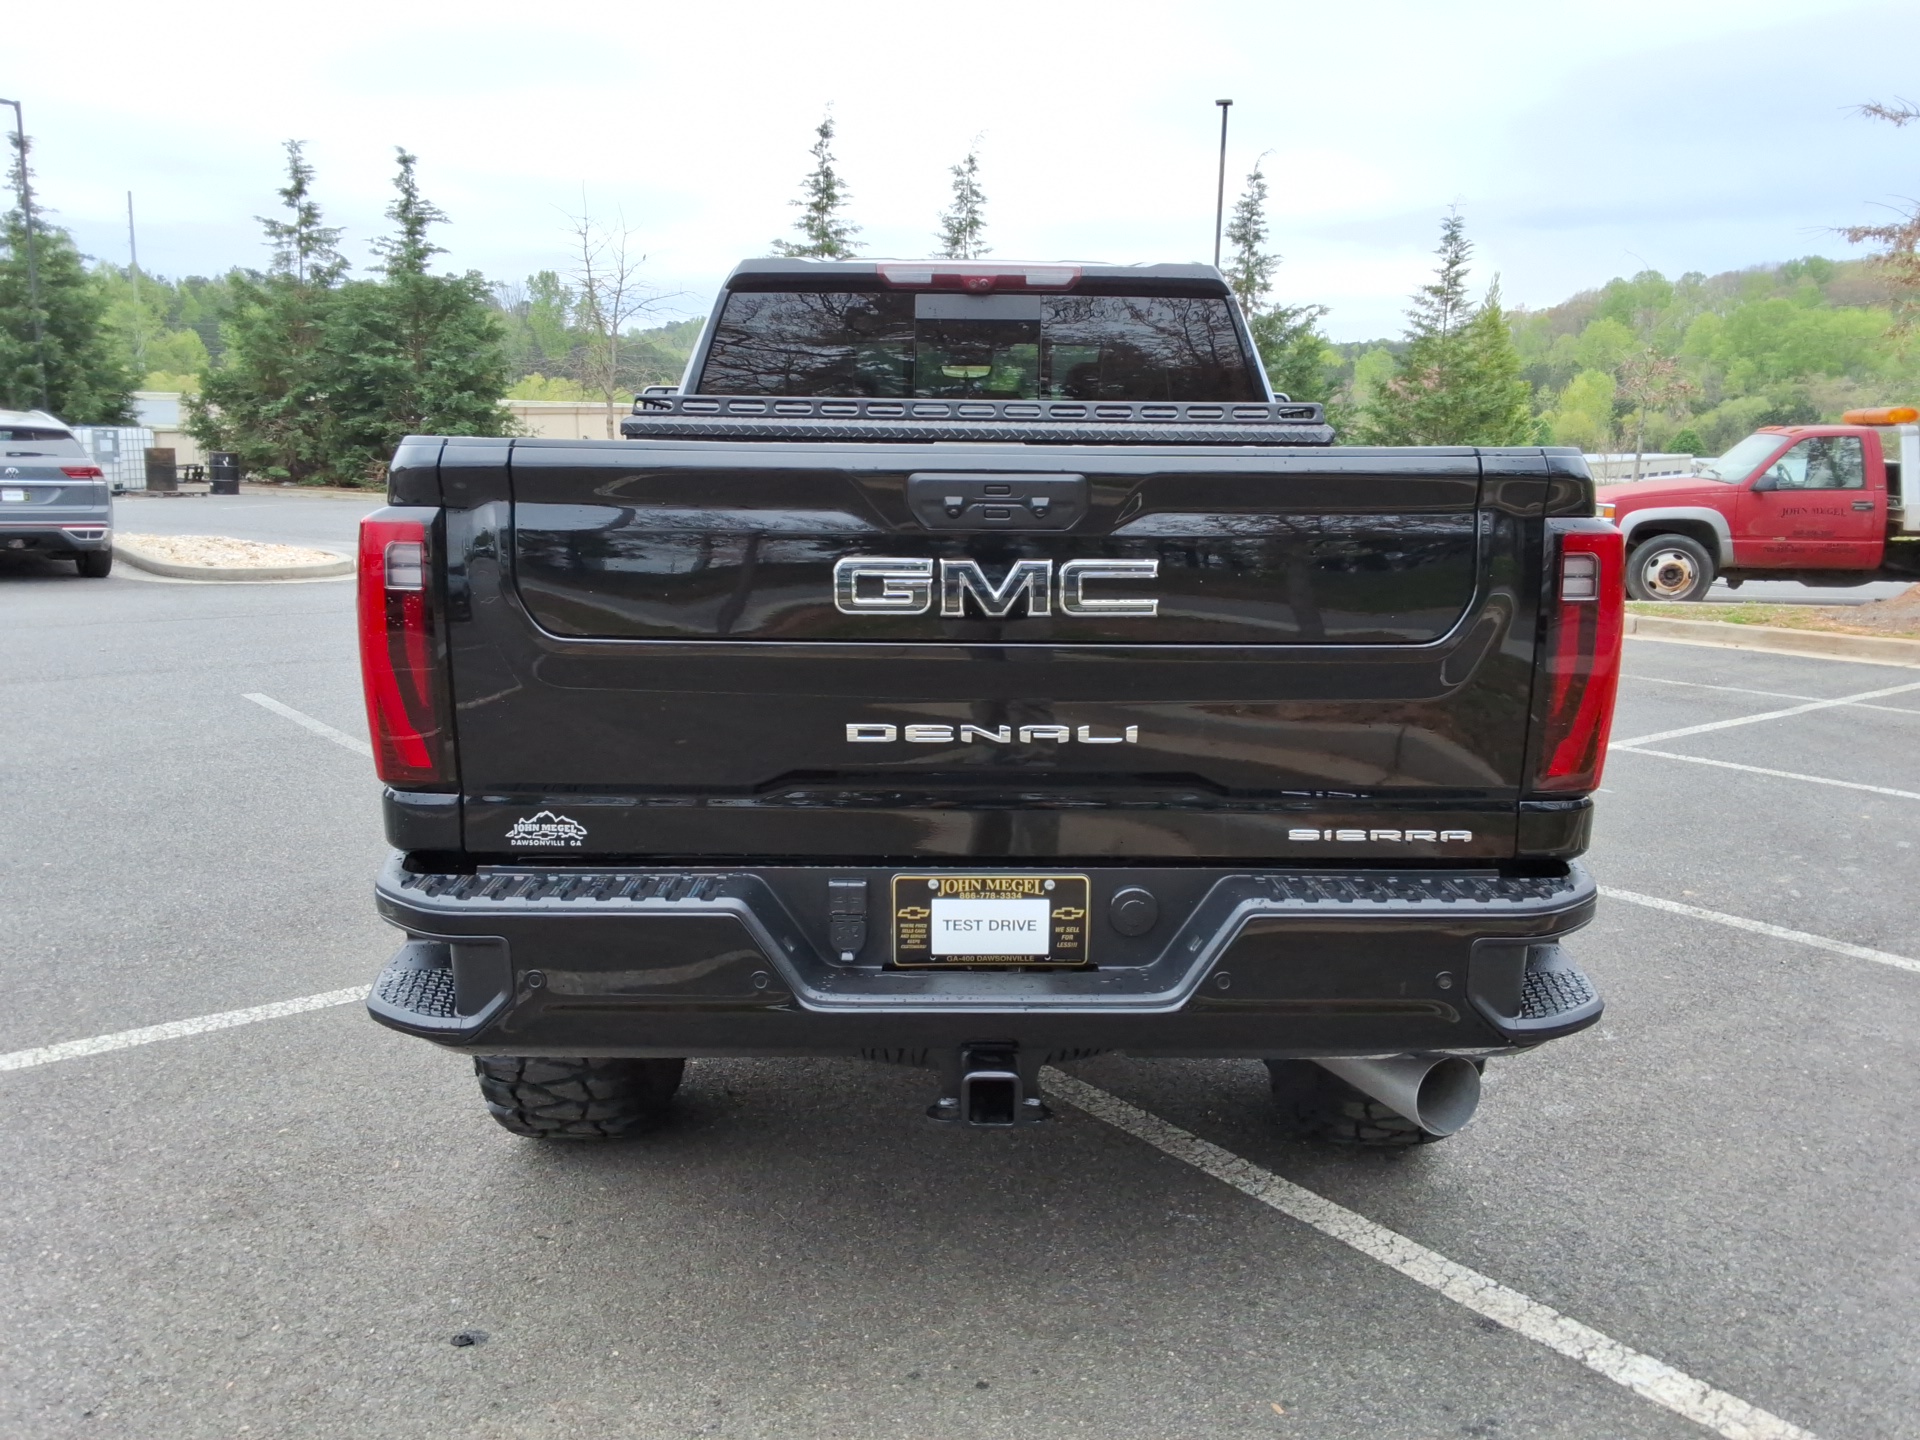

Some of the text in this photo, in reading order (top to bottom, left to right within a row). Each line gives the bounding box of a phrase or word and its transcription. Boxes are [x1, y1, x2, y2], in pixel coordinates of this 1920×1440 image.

[833, 557, 1159, 617] GMC
[846, 723, 1138, 743] DENALI
[513, 823, 577, 834] JOHN MEGEL
[1288, 828, 1473, 843] SIERRA
[937, 879, 1045, 897] JOHN MEGEL
[959, 892, 1022, 900] 866-778-3334
[942, 919, 1037, 932] TEST DRIVE
